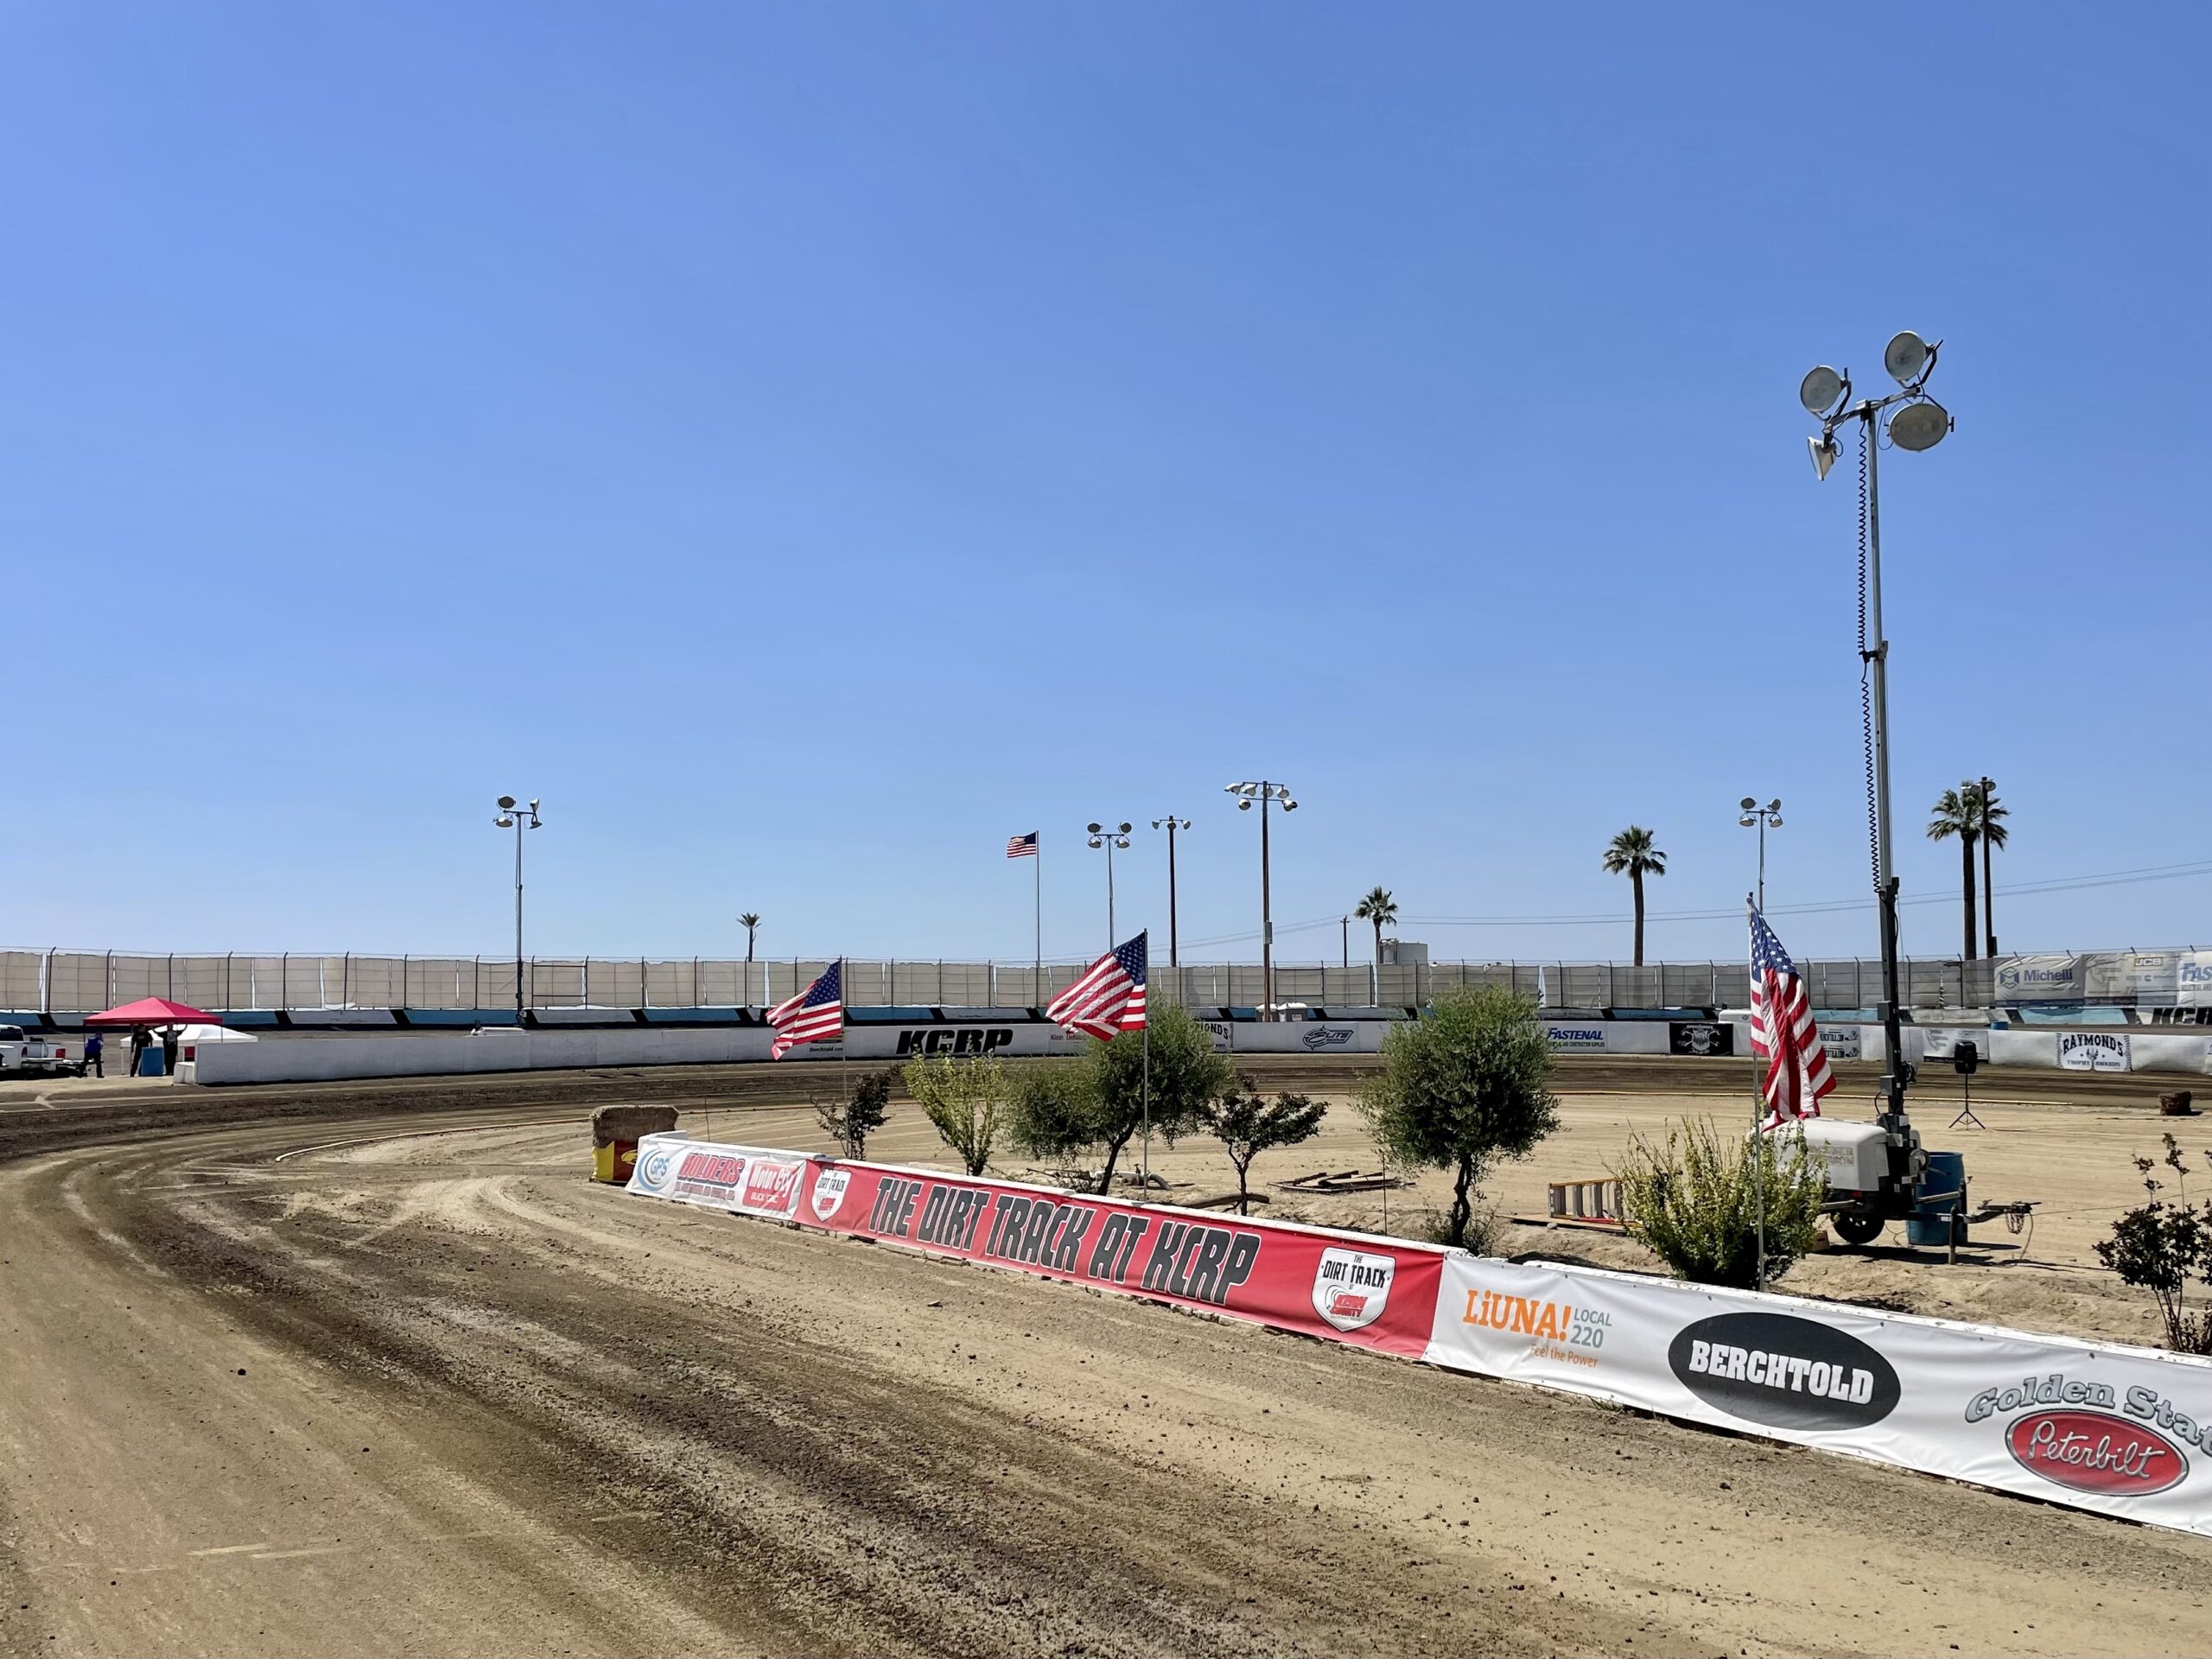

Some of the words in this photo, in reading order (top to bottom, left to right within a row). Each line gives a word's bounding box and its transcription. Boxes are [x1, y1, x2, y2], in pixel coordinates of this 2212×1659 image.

[2135, 957, 2162, 966] JCB
[2024, 969, 2073, 982] Michelli
[896, 1029, 1014, 1054] KCRP
[2063, 1033, 2124, 1056] RAYMONDS
[651, 1157, 670, 1177] GPS
[677, 1152, 746, 1187] HOLDERS
[749, 1165, 776, 1190] Motor
[868, 1176, 925, 1238] THE
[917, 1184, 992, 1251] DIRT
[985, 1193, 1096, 1274] TRACK
[1088, 1212, 1151, 1285] AT
[1140, 1220, 1262, 1306] KCRP
[1323, 1260, 1348, 1281] DIRT
[1351, 1264, 1387, 1288] TRACK
[1573, 1307, 1612, 1326] LOCAL
[1570, 1325, 1605, 1349] 220
[1530, 1344, 1549, 1359] Feel
[1550, 1346, 1566, 1362] the
[1567, 1351, 1599, 1368] Power
[1688, 1339, 1874, 1406] BERCHTOLD
[1965, 1374, 2115, 1423] Golden
[2028, 1421, 2166, 1479] Peterbilt
